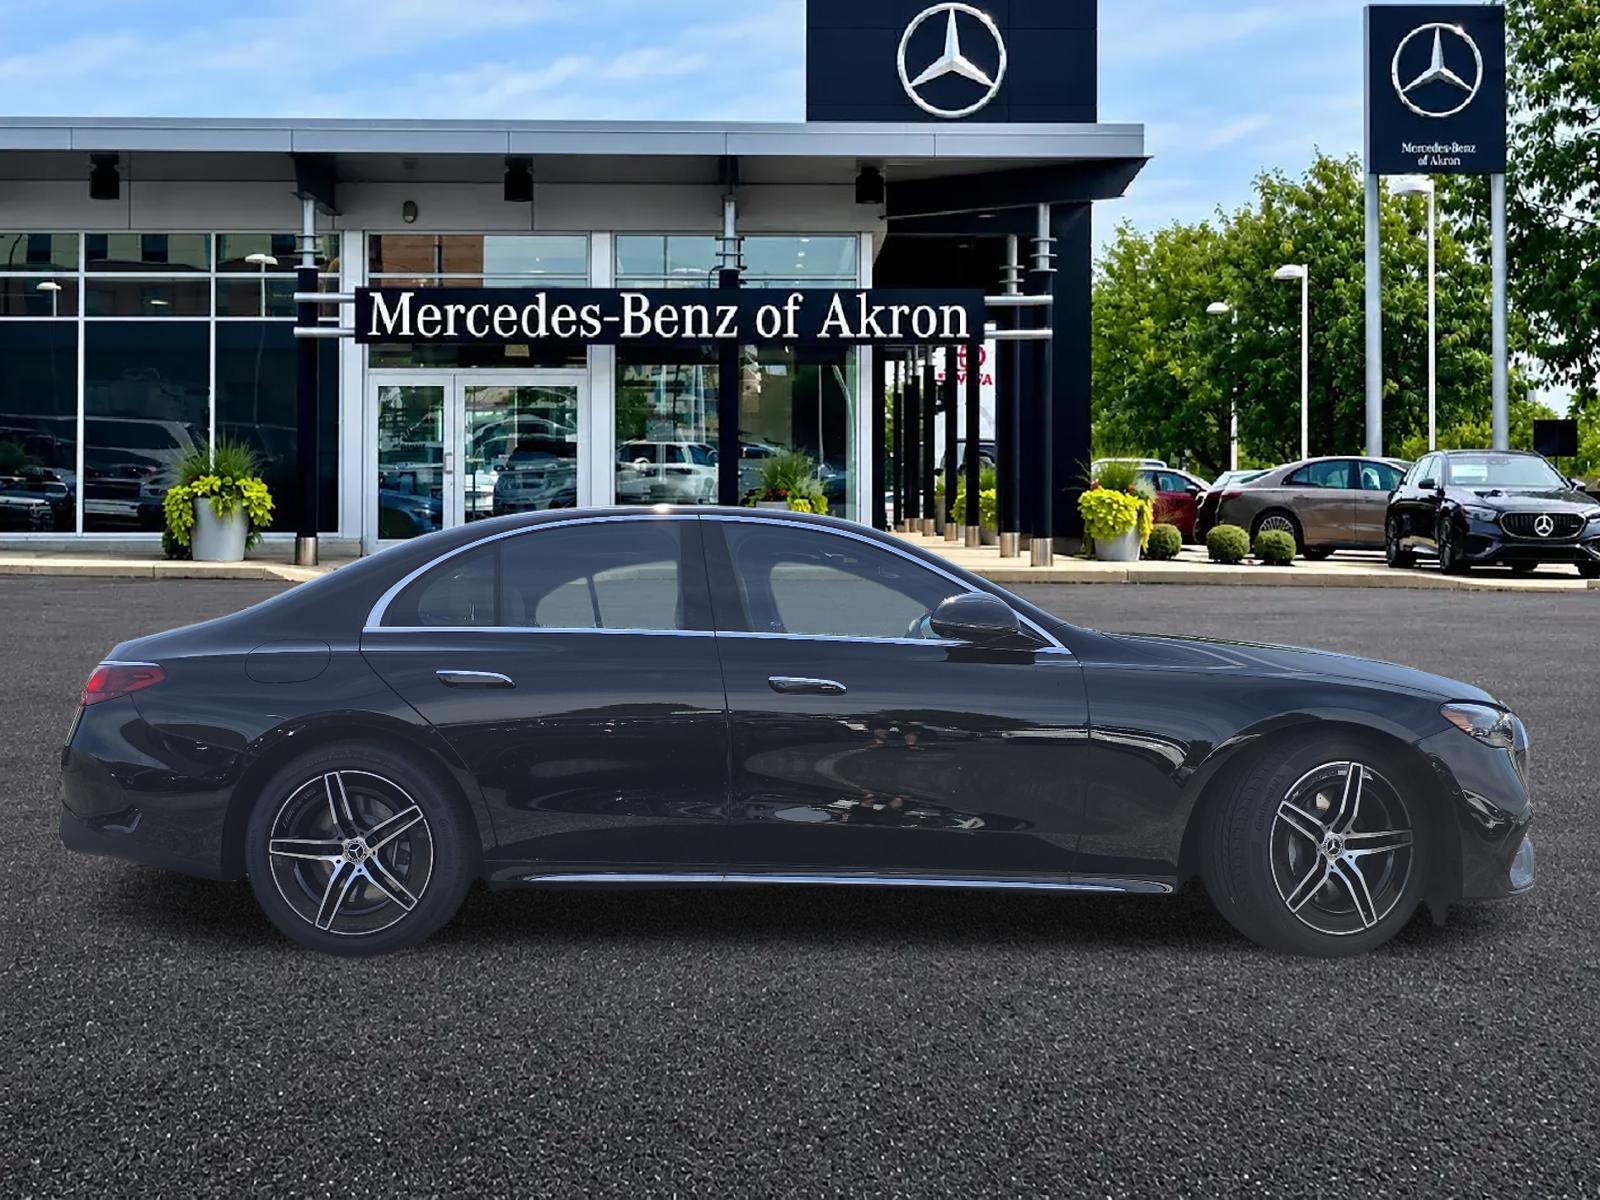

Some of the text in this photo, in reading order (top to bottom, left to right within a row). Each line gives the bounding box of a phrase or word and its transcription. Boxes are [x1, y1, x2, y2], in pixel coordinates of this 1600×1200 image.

[1401, 142, 1477, 154] Mercedes-Benz
[1417, 154, 1461, 166] of Akron
[367, 292, 970, 339] Mercedes-Benz of Akron
